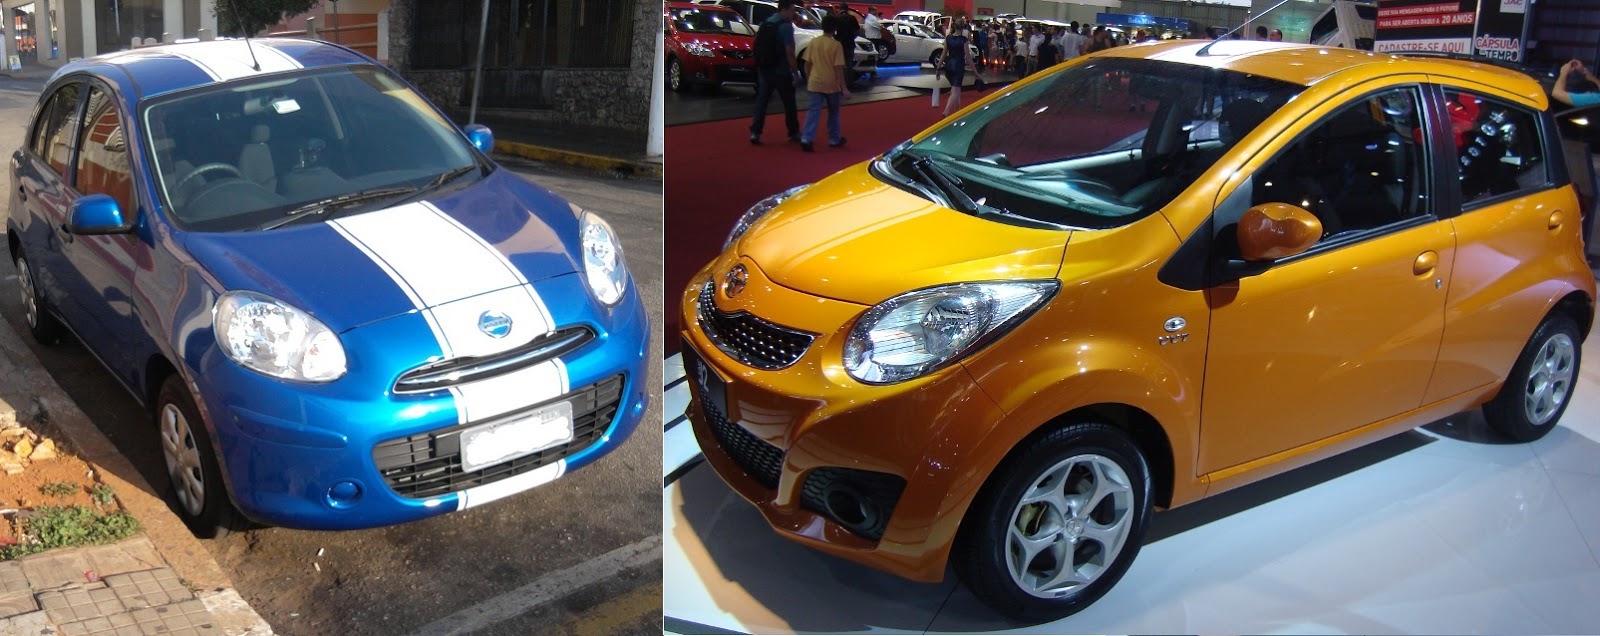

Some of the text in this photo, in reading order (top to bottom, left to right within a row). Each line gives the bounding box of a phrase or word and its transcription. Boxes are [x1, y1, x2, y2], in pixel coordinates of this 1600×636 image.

[1442, 15, 1451, 24] 20
[1452, 14, 1473, 23] ANOS
[1379, 42, 1465, 53] CADASTRE-SE AQUI
[1475, 34, 1519, 50] CÁPSULA
[1486, 50, 1518, 62] TEMPO
